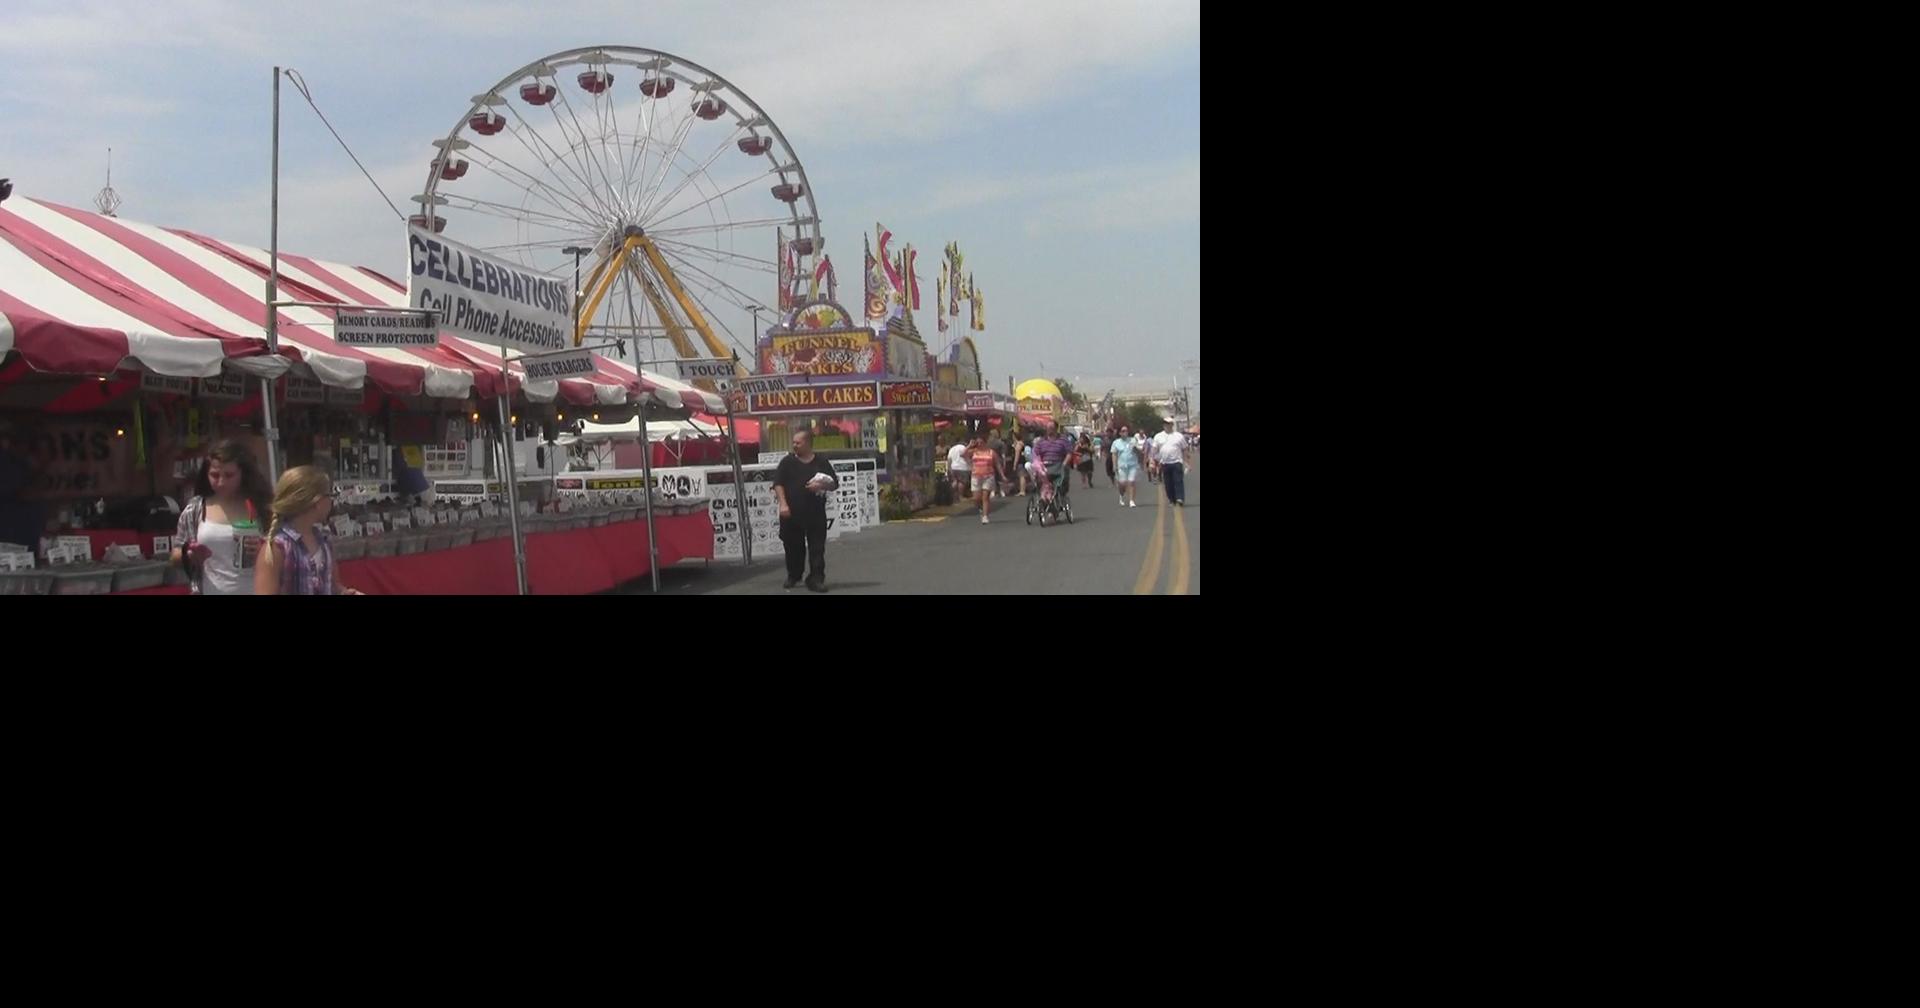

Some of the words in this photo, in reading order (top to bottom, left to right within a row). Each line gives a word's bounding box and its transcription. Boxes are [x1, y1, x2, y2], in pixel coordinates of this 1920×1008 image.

[410, 234, 569, 317] CELLEBRATIONS
[337, 316, 369, 327] MEMORY
[420, 288, 452, 325] Cell
[455, 297, 499, 335] Phone
[500, 310, 565, 349] Accessories
[338, 332, 374, 343] SCREEN
[376, 333, 436, 344] PROTECTORS
[782, 338, 860, 354] FUNNEL
[525, 361, 552, 378] HOUSE
[552, 358, 593, 374] CHARGERS
[689, 364, 735, 376] TOUCH
[791, 361, 854, 375] CAKES
[740, 380, 769, 394] OTTER
[768, 378, 786, 391] BOX
[757, 389, 819, 406] FUNNEL
[822, 386, 873, 404] CAKES
